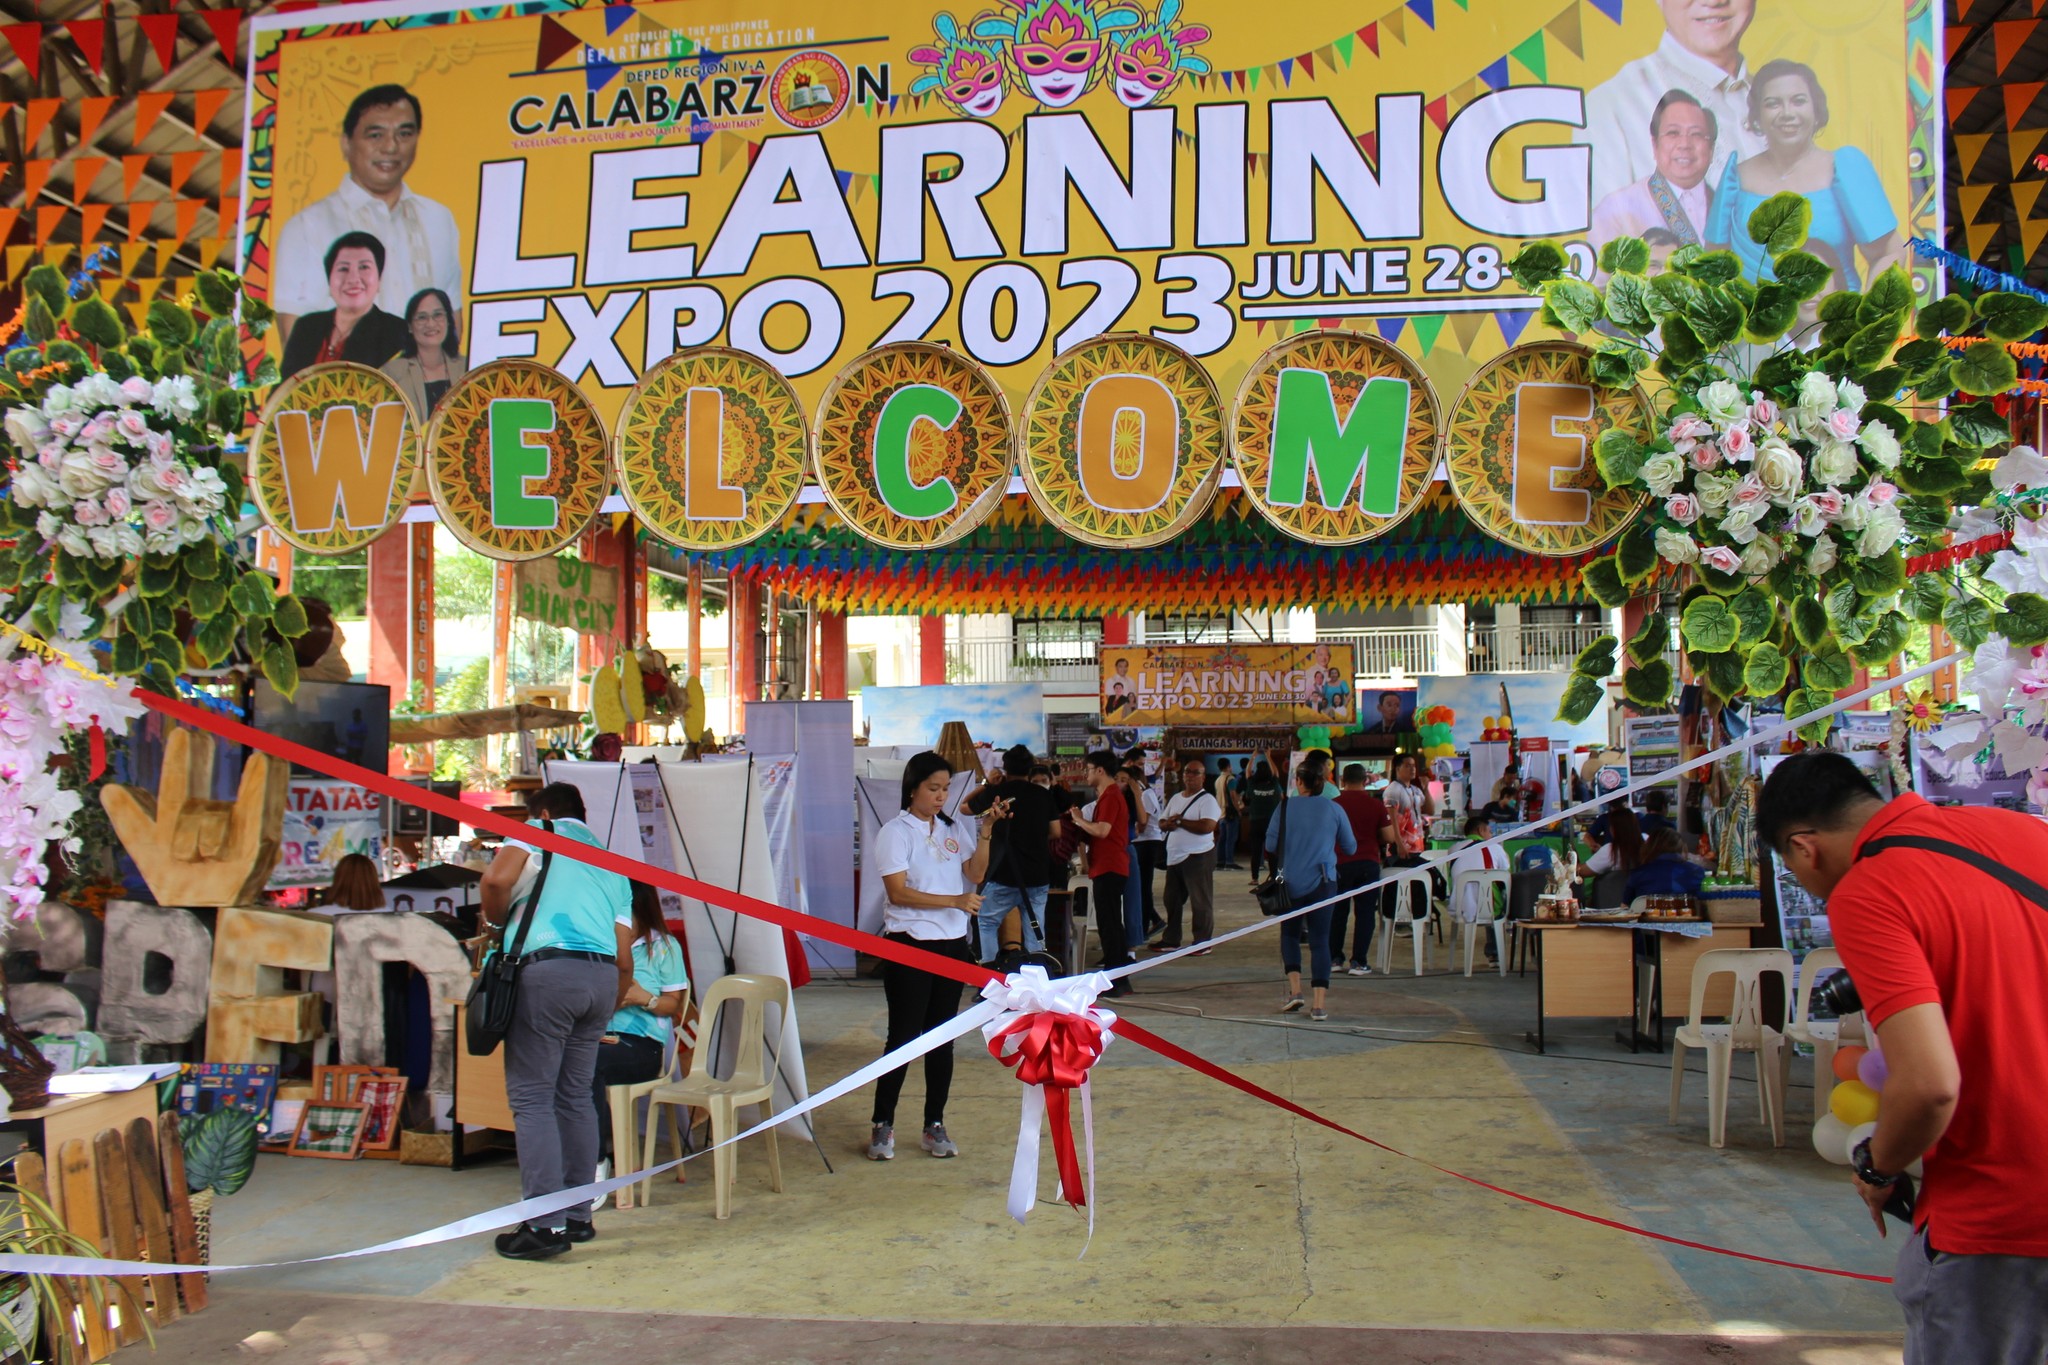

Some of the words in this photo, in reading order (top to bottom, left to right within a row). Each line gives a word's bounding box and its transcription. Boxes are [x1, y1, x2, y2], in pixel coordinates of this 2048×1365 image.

[623, 29, 668, 43] REPUBLIC
[672, 28, 684, 39] OF
[688, 26, 705, 37] THE
[709, 20, 769, 35] PHILIPPINES
[577, 39, 684, 64] DEPARTMENT
[693, 36, 711, 52] OF
[722, 27, 816, 50] EDUCATION
[627, 68, 670, 83] DEPED
[674, 63, 729, 79] REGION
[733, 59, 766, 72] IV-A
[587, 131, 627, 143] CULTURE
[628, 130, 644, 140] and
[645, 125, 683, 138] QUALITY
[471, 84, 1593, 296] LEARNING
[1240, 246, 1410, 299] JUNE
[1424, 239, 1597, 292] 28-0
[466, 275, 845, 388] EXPO
[870, 254, 1236, 367] 2023
[275, 367, 1594, 533] WELCOME
[1137, 670, 1307, 694] LEARNING
[1136, 693, 1196, 711] EXPO
[1200, 692, 1255, 710] 2023
[1255, 692, 1279, 701] JUNE
[1182, 736, 1233, 749] BATANGAS
[1236, 736, 1286, 749] PROVINCE
[285, 786, 380, 812] TATAG
